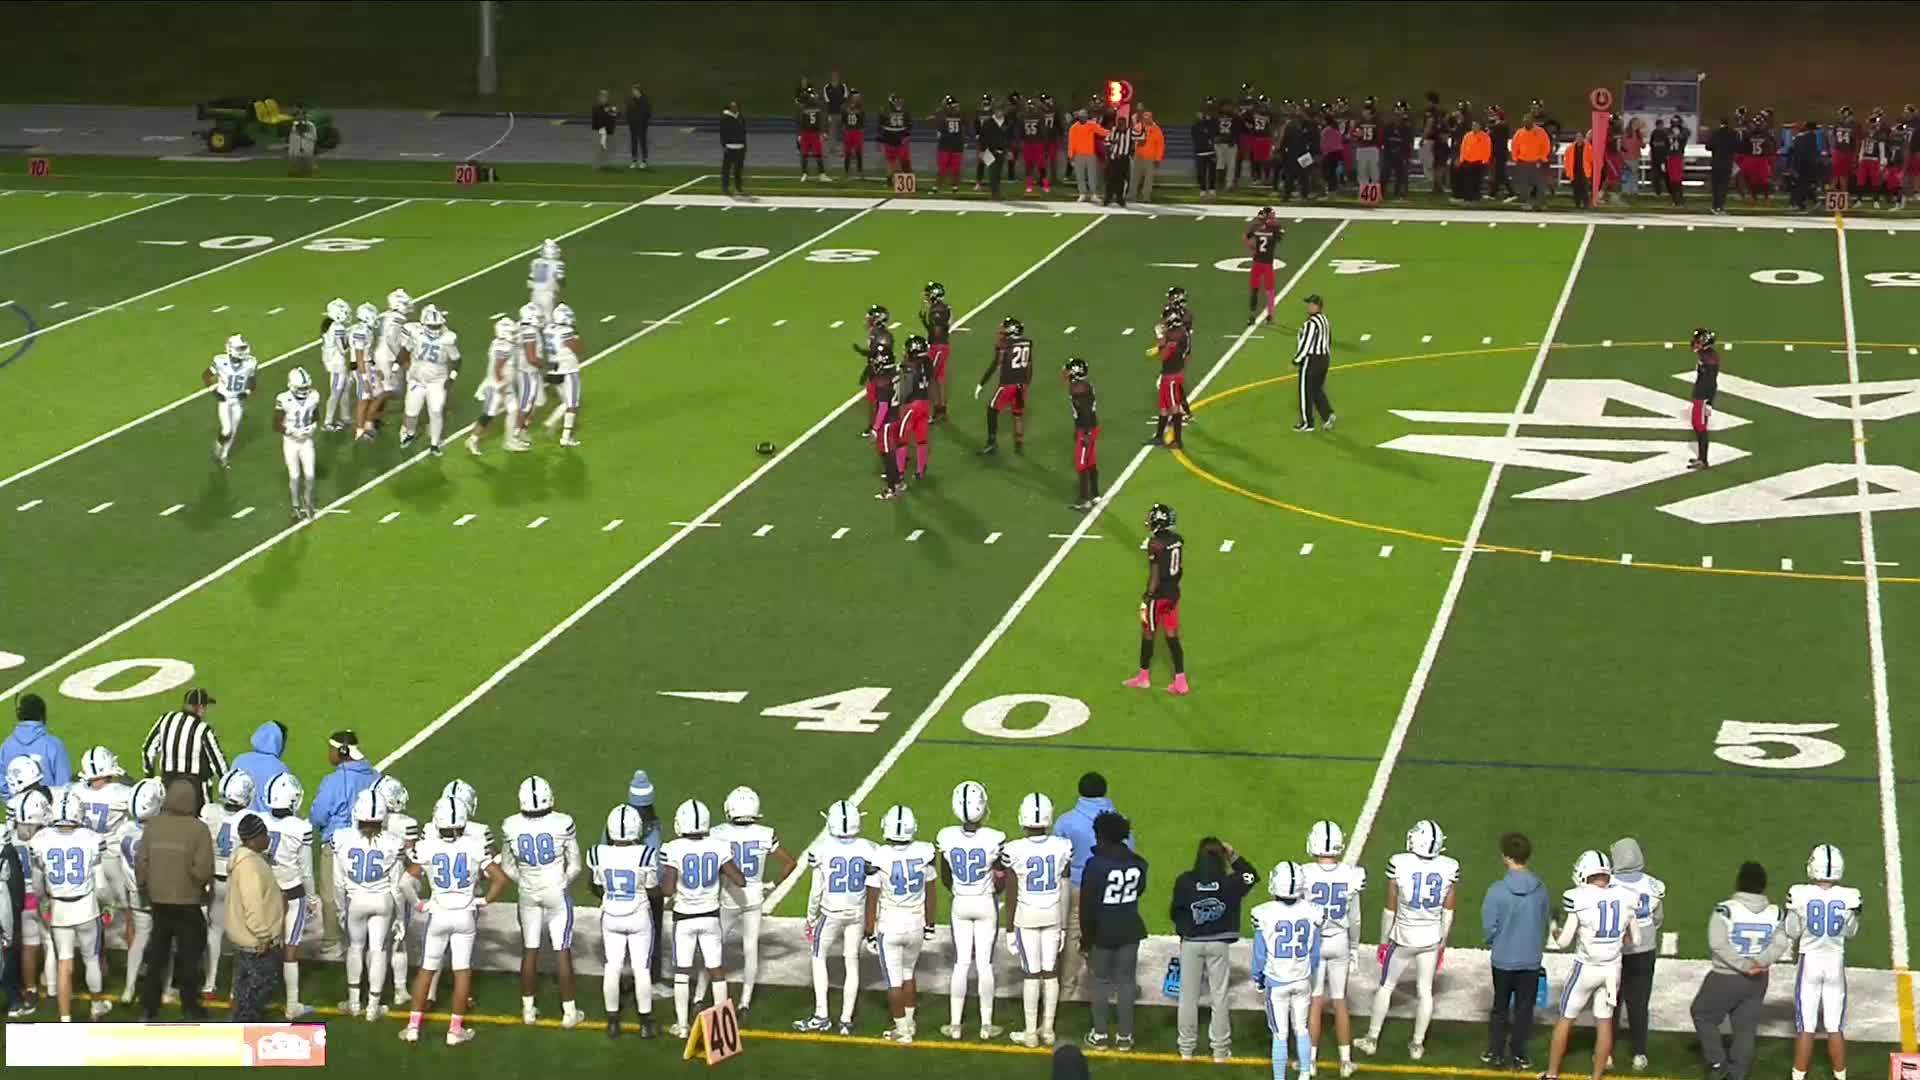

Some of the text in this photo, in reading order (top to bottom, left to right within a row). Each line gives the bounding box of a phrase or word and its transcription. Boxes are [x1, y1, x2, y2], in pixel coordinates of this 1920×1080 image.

[456, 168, 472, 183] 20
[896, 176, 914, 191] 30
[1360, 187, 1378, 202] 40
[1828, 193, 1846, 209] 50
[1259, 236, 1268, 252] 2
[419, 343, 440, 364] 75
[1012, 346, 1029, 368] 20
[227, 374, 244, 389] 16
[48, 848, 85, 885] 33
[347, 848, 384, 884] 36
[517, 833, 554, 866] 88
[951, 848, 986, 882] 82
[432, 852, 470, 889] 34
[681, 852, 719, 889] 80
[829, 856, 864, 893] 28
[890, 859, 924, 895] 45
[1026, 856, 1058, 892] 21
[1103, 868, 1141, 904] 22
[1311, 882, 1348, 920] 25
[1412, 872, 1442, 909] 13
[1596, 900, 1620, 938] 11
[1807, 899, 1845, 937] 86
[1274, 919, 1309, 959] 23
[710, 1009, 737, 1057] 40
